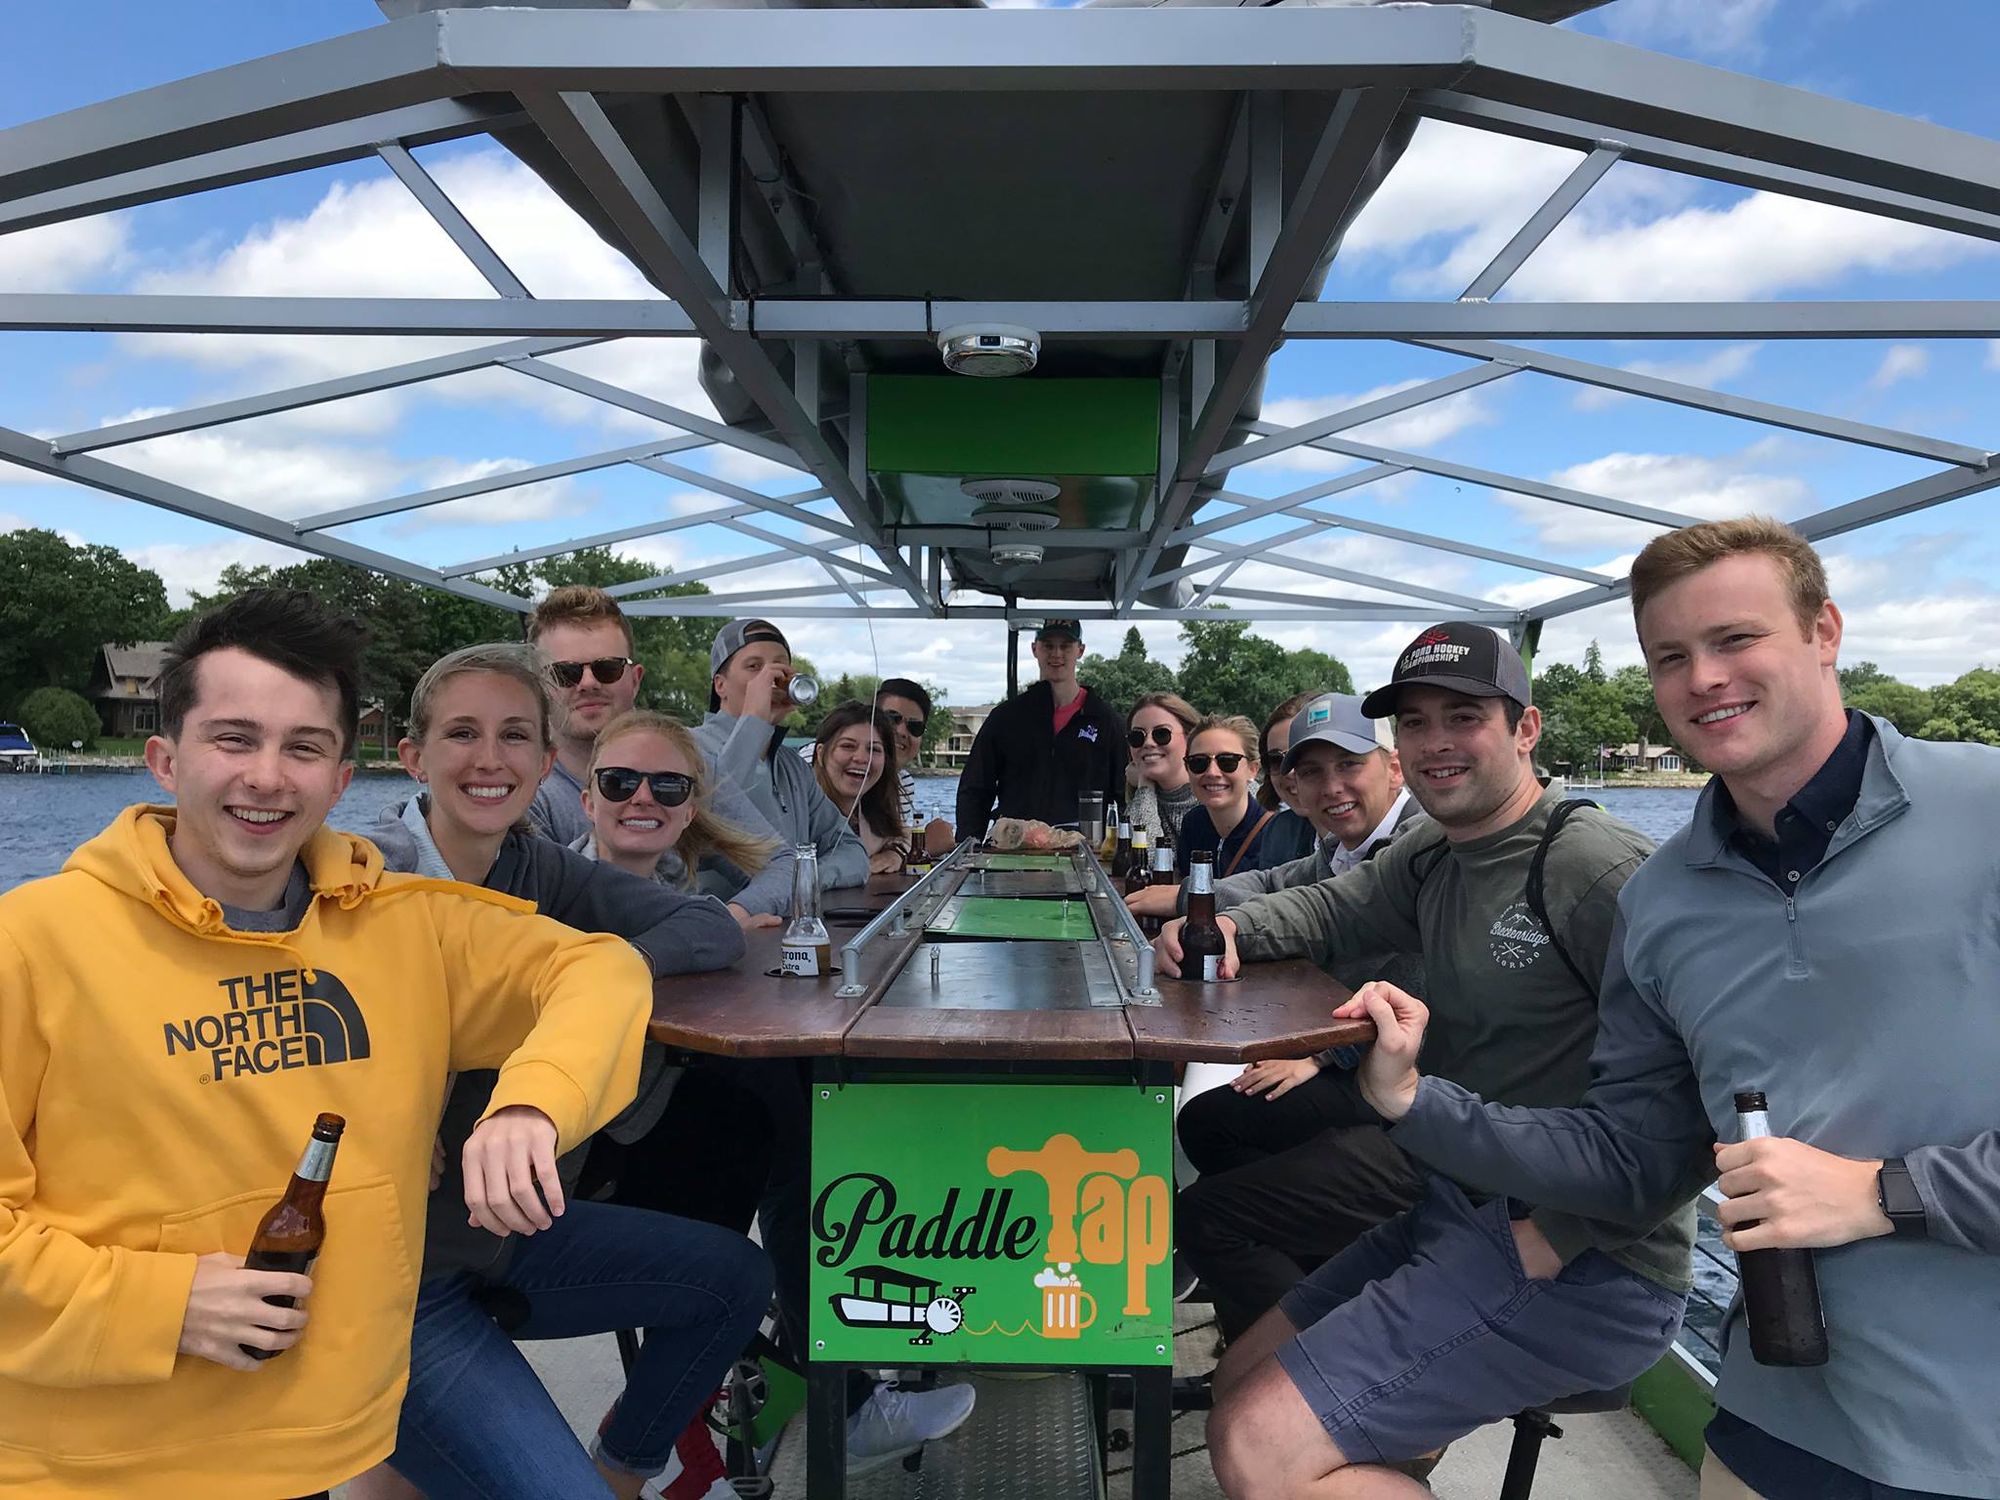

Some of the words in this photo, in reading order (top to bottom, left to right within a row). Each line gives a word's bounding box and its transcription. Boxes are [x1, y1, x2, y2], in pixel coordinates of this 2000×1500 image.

[1401, 654, 1459, 674] CHAMPIONSHIPS
[1411, 645, 1432, 660] POND
[1434, 644, 1470, 655] HOCKEY
[1490, 922, 1550, 947] Breckenridge
[218, 969, 299, 1010] THE
[163, 1003, 301, 1056] NORTH
[212, 1036, 305, 1081] FACE
[812, 1172, 1041, 1268] Paddle
[986, 1133, 1170, 1316] Tap
